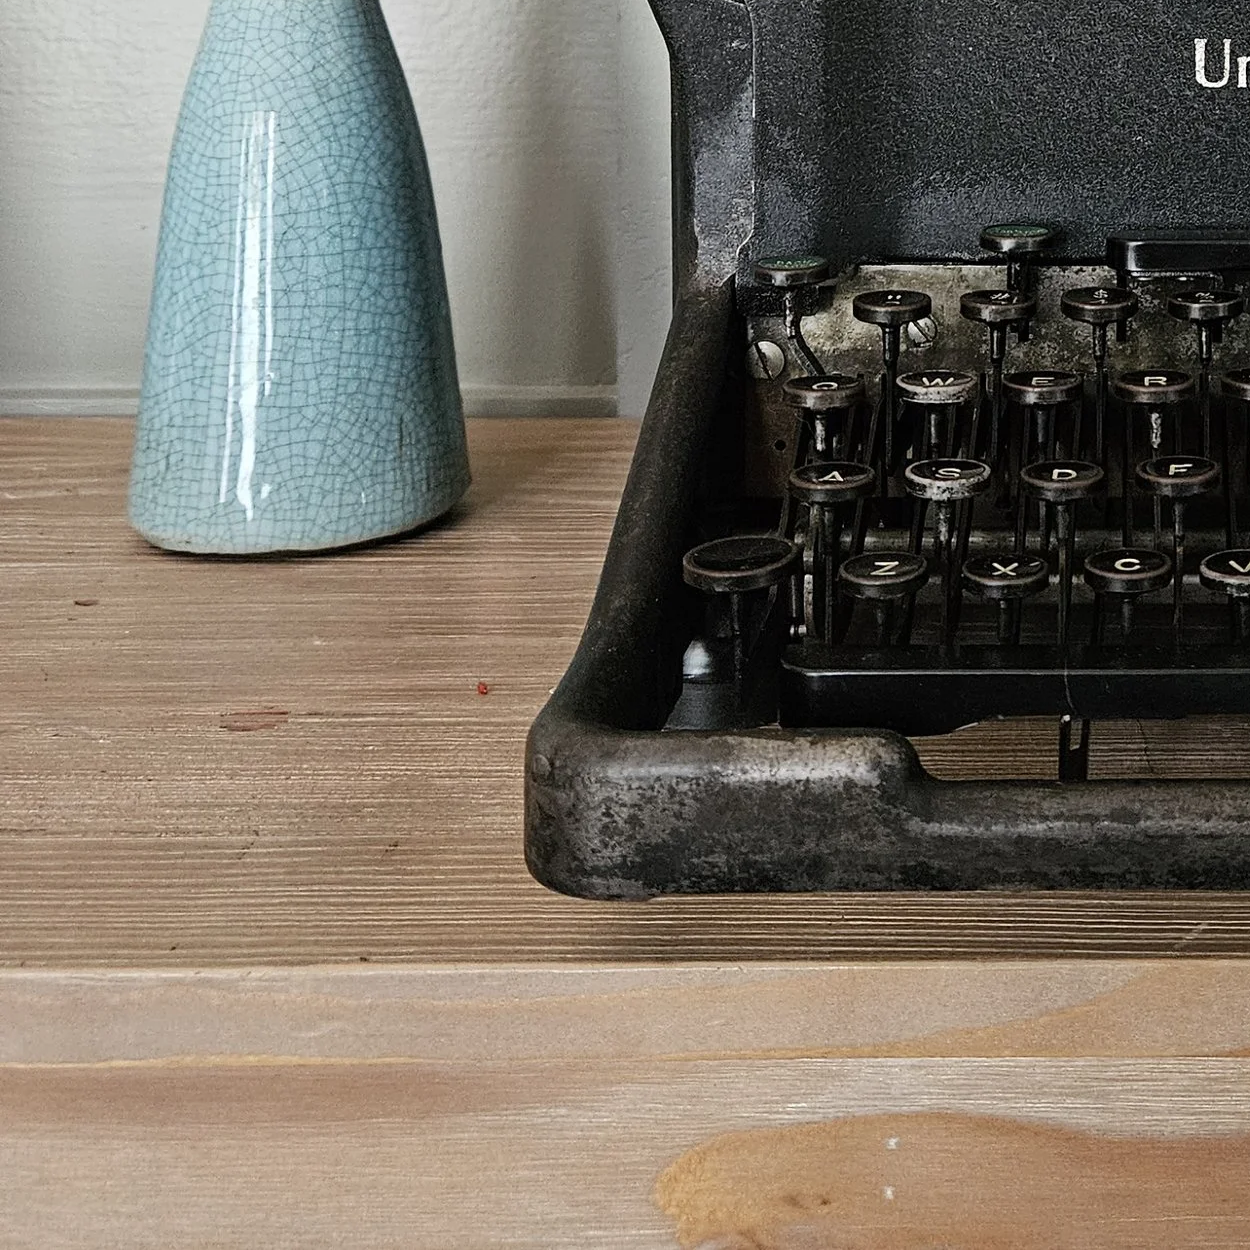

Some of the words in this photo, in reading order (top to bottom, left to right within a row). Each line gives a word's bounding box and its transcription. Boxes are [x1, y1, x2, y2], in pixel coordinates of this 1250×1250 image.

[1143, 376, 1168, 386] R
[818, 471, 844, 482] A
[934, 468, 962, 478] S
[1051, 469, 1077, 480] D
[1168, 464, 1194, 476] F
[870, 561, 899, 576] Z
[992, 562, 1019, 576] X
[1114, 558, 1141, 571] C
